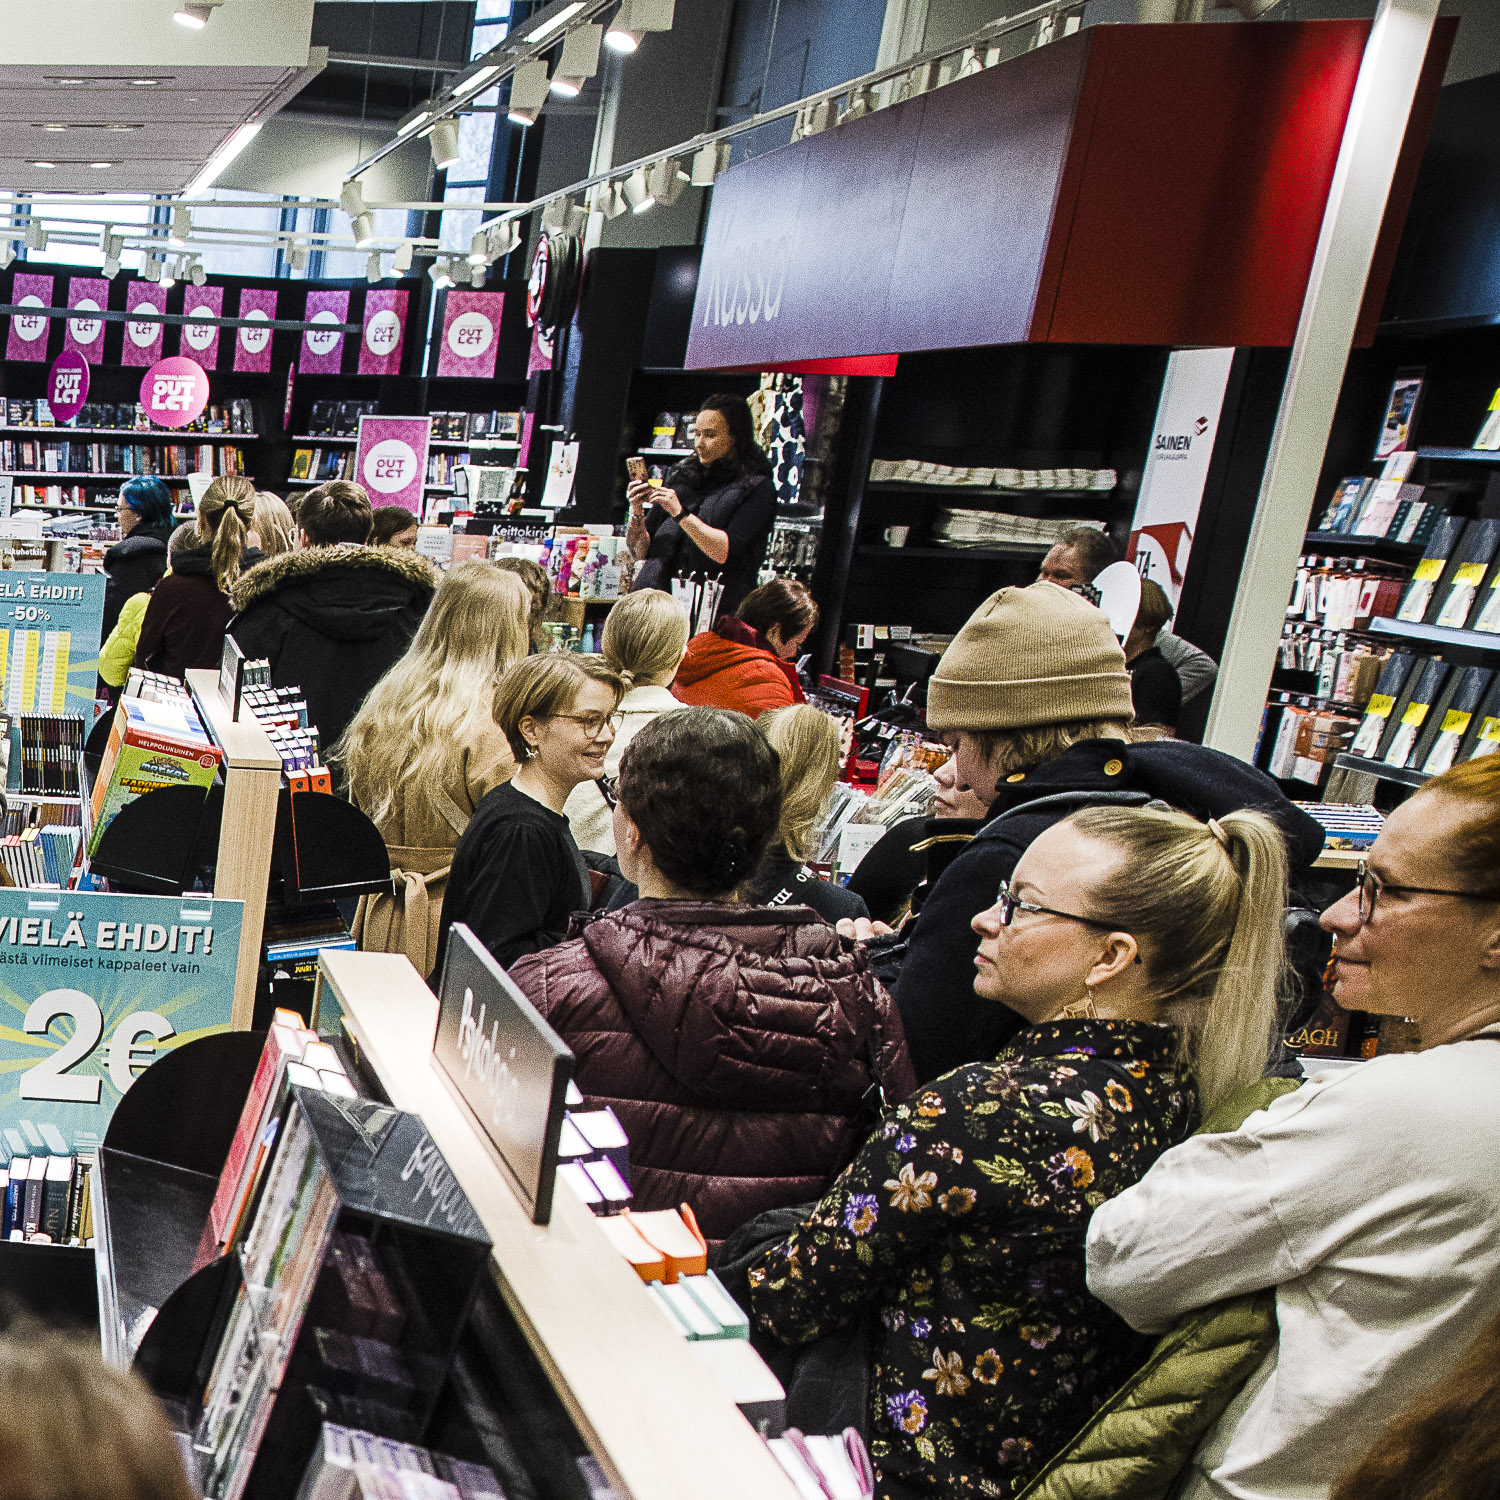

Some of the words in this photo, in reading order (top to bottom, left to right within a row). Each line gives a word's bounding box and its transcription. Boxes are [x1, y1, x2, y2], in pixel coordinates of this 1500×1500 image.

[375, 326, 394, 336] OUT
[459, 327, 484, 337] OUT
[55, 374, 82, 389] OUT
[153, 380, 195, 396] OUT
[376, 459, 405, 468] OUT
[492, 523, 550, 538] Keittokirja
[29, 584, 83, 600] EHDIT!
[6, 605, 51, 620] -50%
[138, 739, 195, 757] HELPPOLUKUINEN
[95, 919, 215, 955] EHDIT!
[32, 952, 93, 970] viimeiset
[98, 956, 167, 975] kappaleet
[171, 959, 201, 974] vain
[18, 988, 176, 1102] 2€
